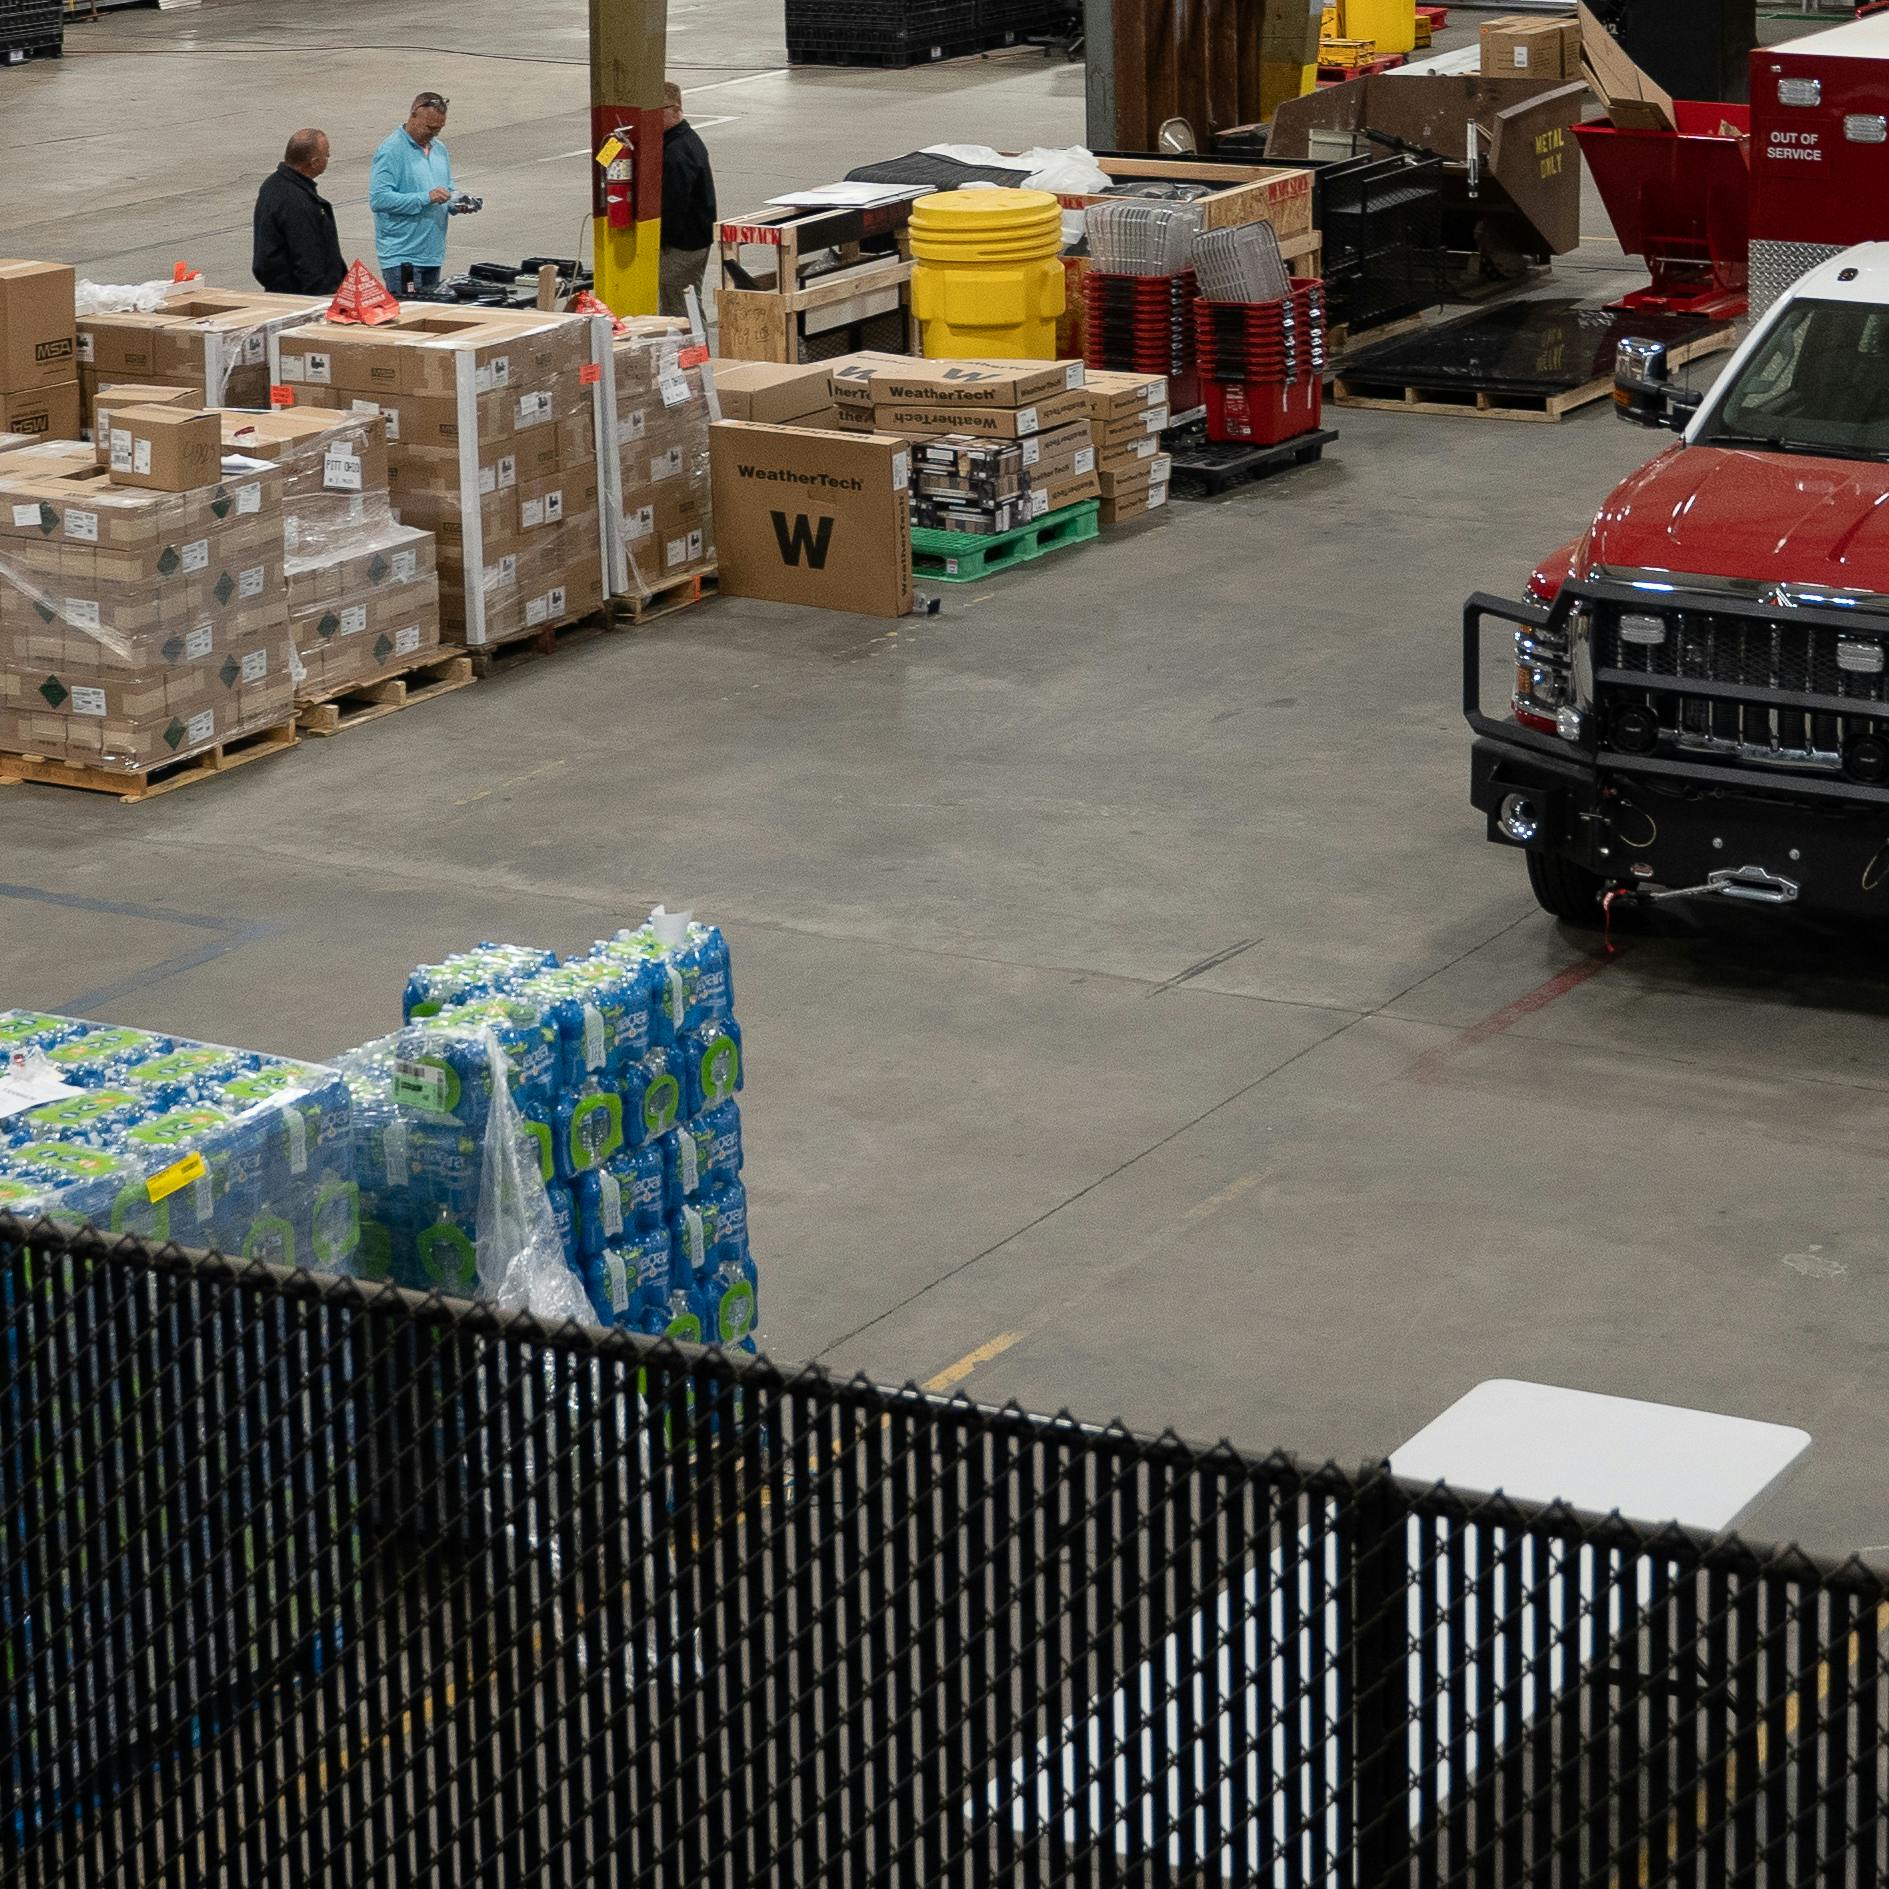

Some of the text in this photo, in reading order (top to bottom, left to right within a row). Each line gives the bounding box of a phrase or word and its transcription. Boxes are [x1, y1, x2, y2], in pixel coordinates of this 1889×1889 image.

[1535, 127, 1565, 155] METAL
[1770, 131, 1819, 145] OUT OF
[1767, 146, 1822, 161] SERVICE
[37, 340, 72, 359] MSA
[889, 385, 996, 400] WeatherTech
[894, 413, 997, 429] WeatherTech
[737, 464, 863, 492] WeatherTech
[1031, 463, 1070, 483] eatherTech
[770, 510, 835, 570] W
